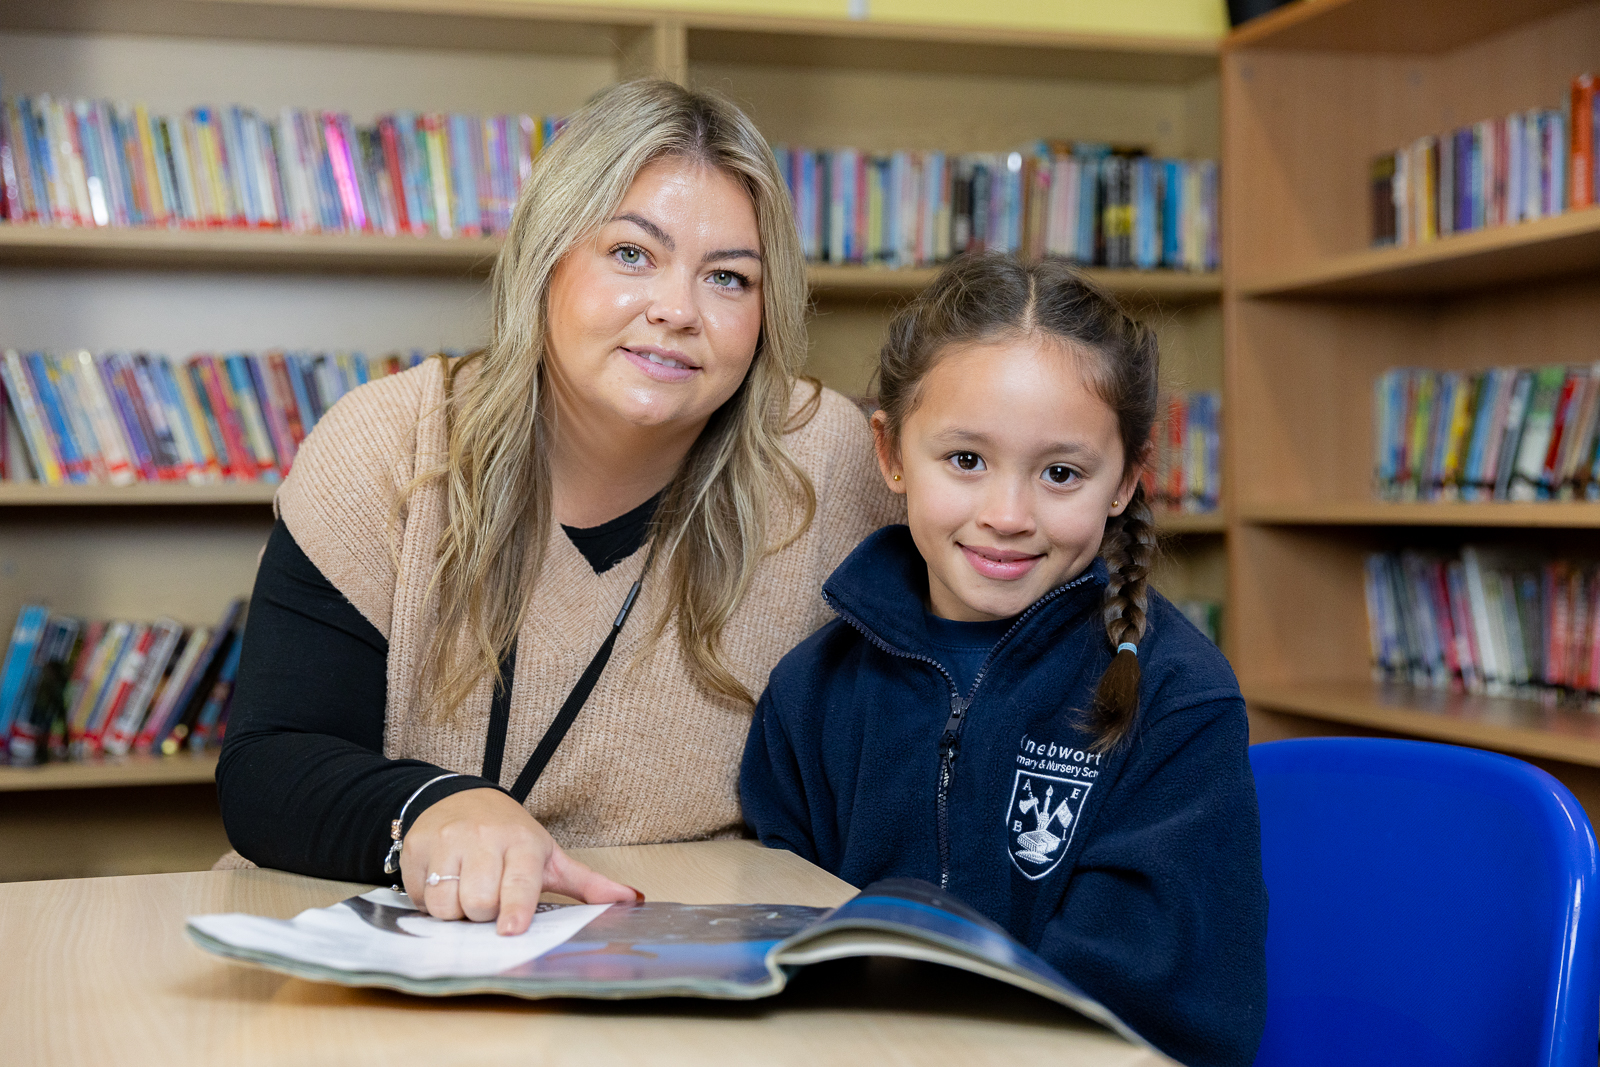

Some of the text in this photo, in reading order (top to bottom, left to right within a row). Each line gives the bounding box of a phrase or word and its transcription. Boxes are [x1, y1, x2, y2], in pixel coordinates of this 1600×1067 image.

[1020, 733, 1101, 765] nebwort
[1016, 754, 1099, 778] mary & Nursery Sch
[1022, 778, 1081, 799] A E
[1012, 819, 1023, 832] B
